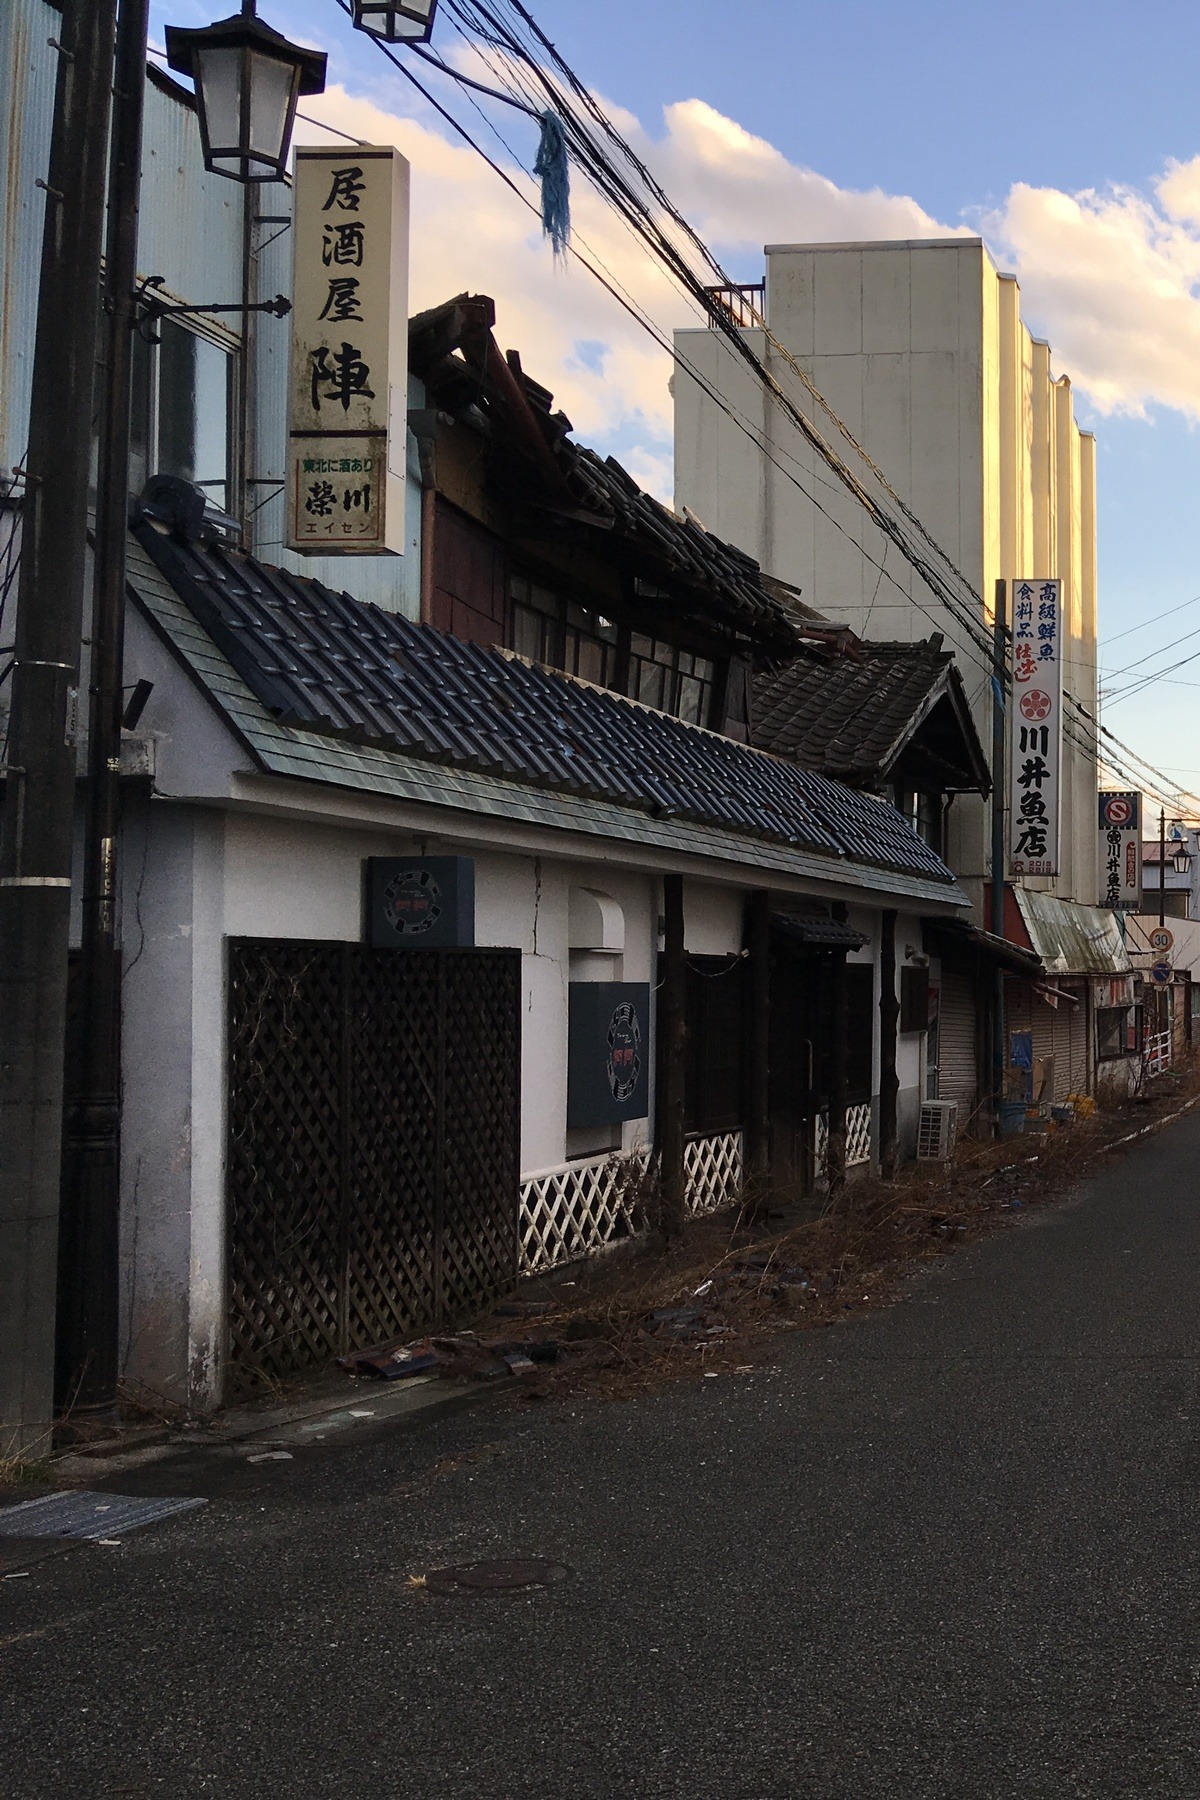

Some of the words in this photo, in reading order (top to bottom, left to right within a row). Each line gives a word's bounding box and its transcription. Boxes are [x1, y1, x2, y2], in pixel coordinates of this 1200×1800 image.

[303, 458, 373, 473] 東北に酒あり
[305, 522, 370, 534] エイセン
[1037, 582, 1057, 662] 高級鮮魚
[1013, 725, 1051, 859] 川井魚店
[1106, 843, 1121, 901] 川井魚店
[1154, 934, 1168, 946] 30
